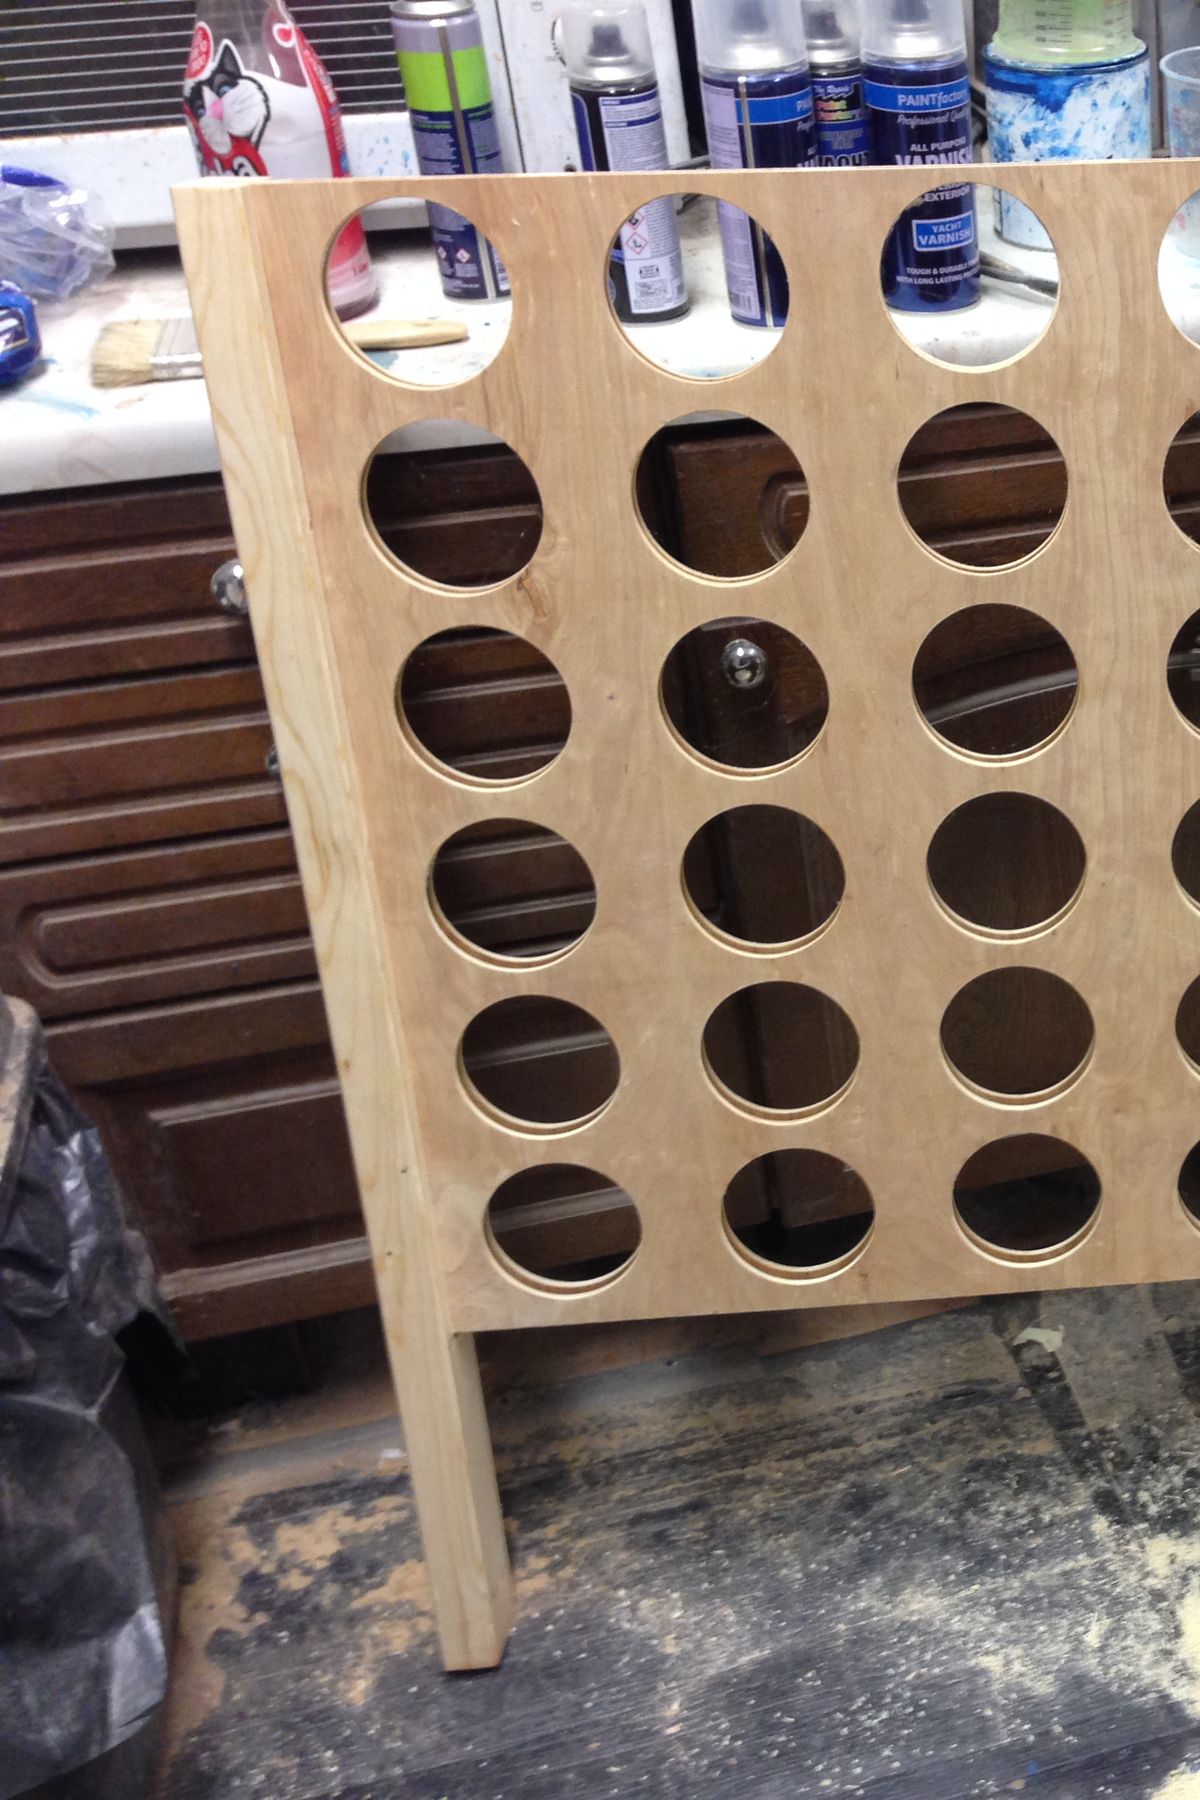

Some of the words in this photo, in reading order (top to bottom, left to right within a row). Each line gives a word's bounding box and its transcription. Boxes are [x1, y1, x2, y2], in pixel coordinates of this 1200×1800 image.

[910, 143, 929, 152] ALL
[931, 221, 962, 234] YACHT
[918, 228, 972, 246] VARNISH
